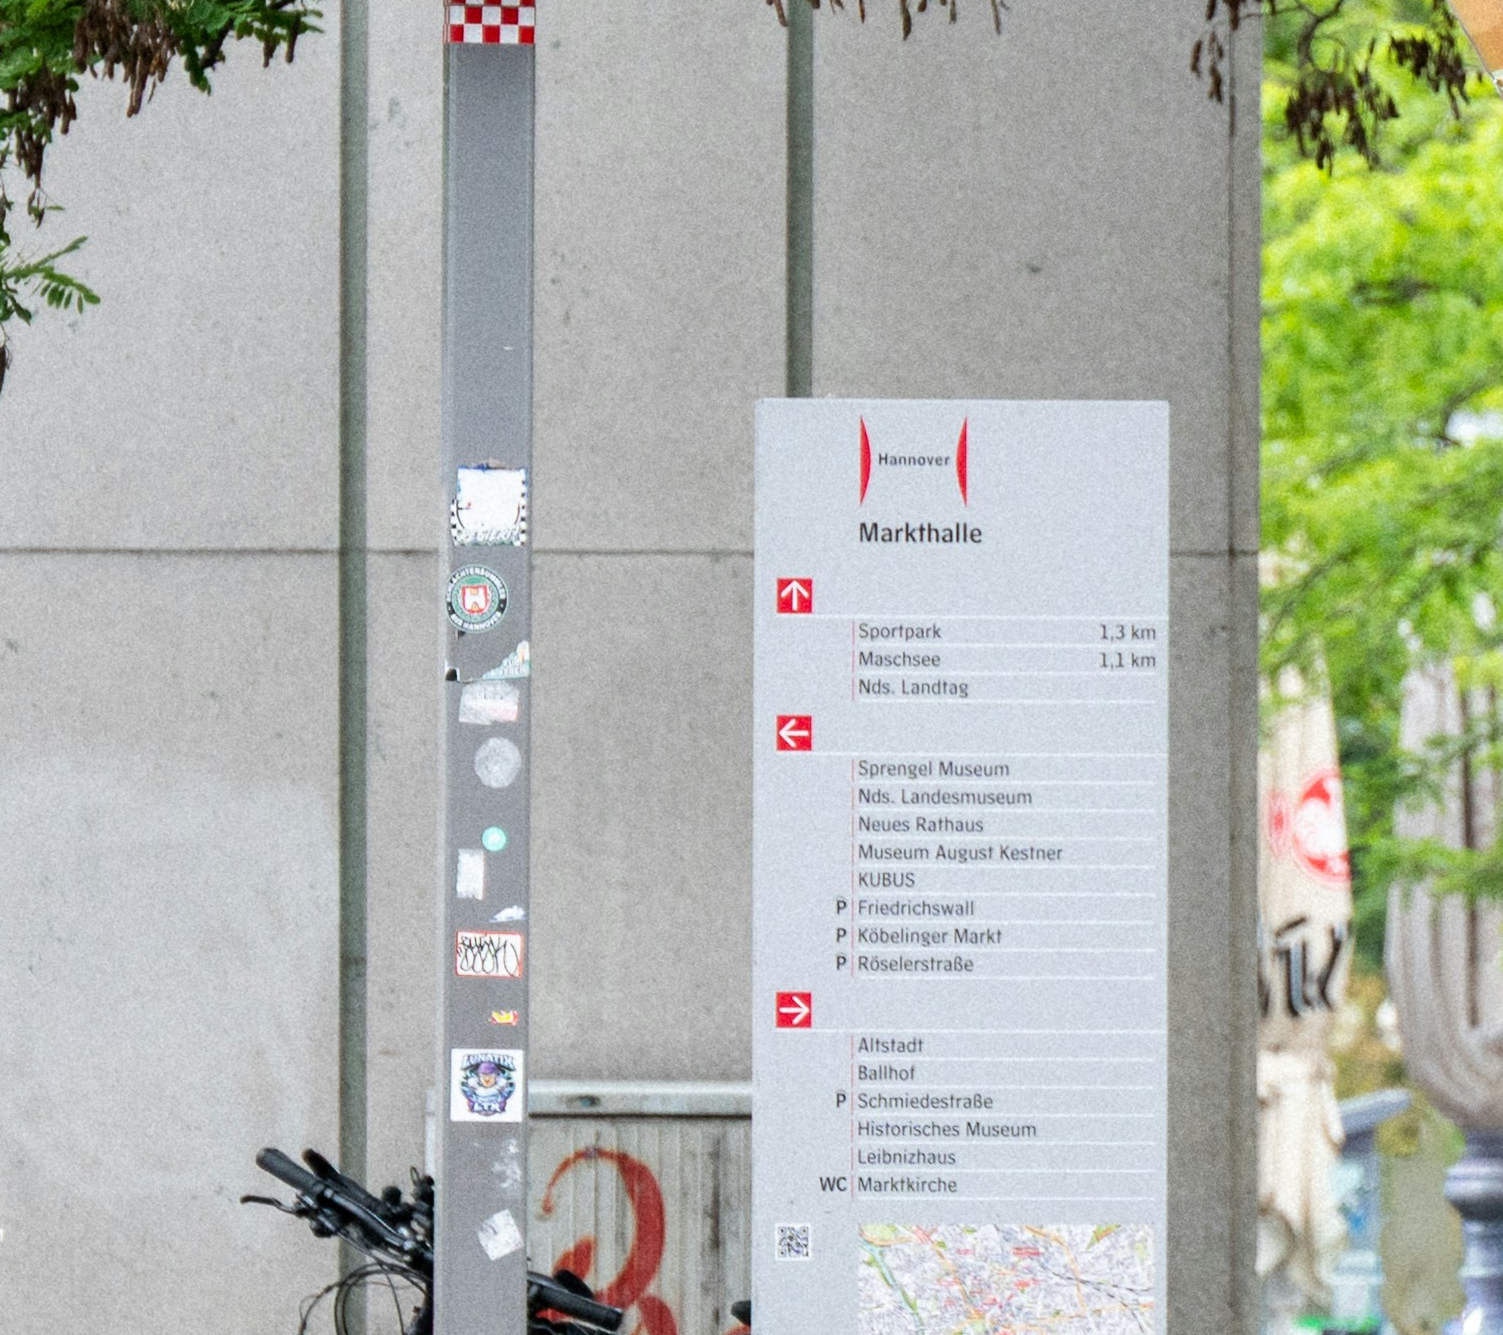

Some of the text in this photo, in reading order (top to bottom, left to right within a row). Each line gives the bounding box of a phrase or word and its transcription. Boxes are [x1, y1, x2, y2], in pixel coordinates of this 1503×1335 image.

[877, 452, 950, 467] Hannover
[859, 521, 983, 544] Markthalle
[858, 622, 1157, 642] Sportpark 1,3 km
[858, 650, 1157, 669] Maschsee 1,1 km
[858, 678, 969, 699] Nds. Landtag
[858, 759, 1010, 780] Sprengel Museum
[858, 787, 1033, 806] Nds. Landesmuseum
[858, 815, 984, 833] Neues Rathaus
[858, 843, 1063, 864] Museum August Kestner
[858, 871, 916, 888] KUBUS
[836, 899, 975, 917] P Friedrichswall
[836, 927, 1002, 948] P Köbelinger Markt
[835, 954, 974, 973] P Röselerstraße
[857, 1036, 924, 1054] Altstadt
[857, 1064, 916, 1082] Ballhof
[836, 1092, 994, 1110] P Schmiedestraße
[857, 1120, 1037, 1138] Historisches Museum
[857, 1148, 957, 1166] Leibnizhaus
[819, 1176, 958, 1193] WC Marktkirche
